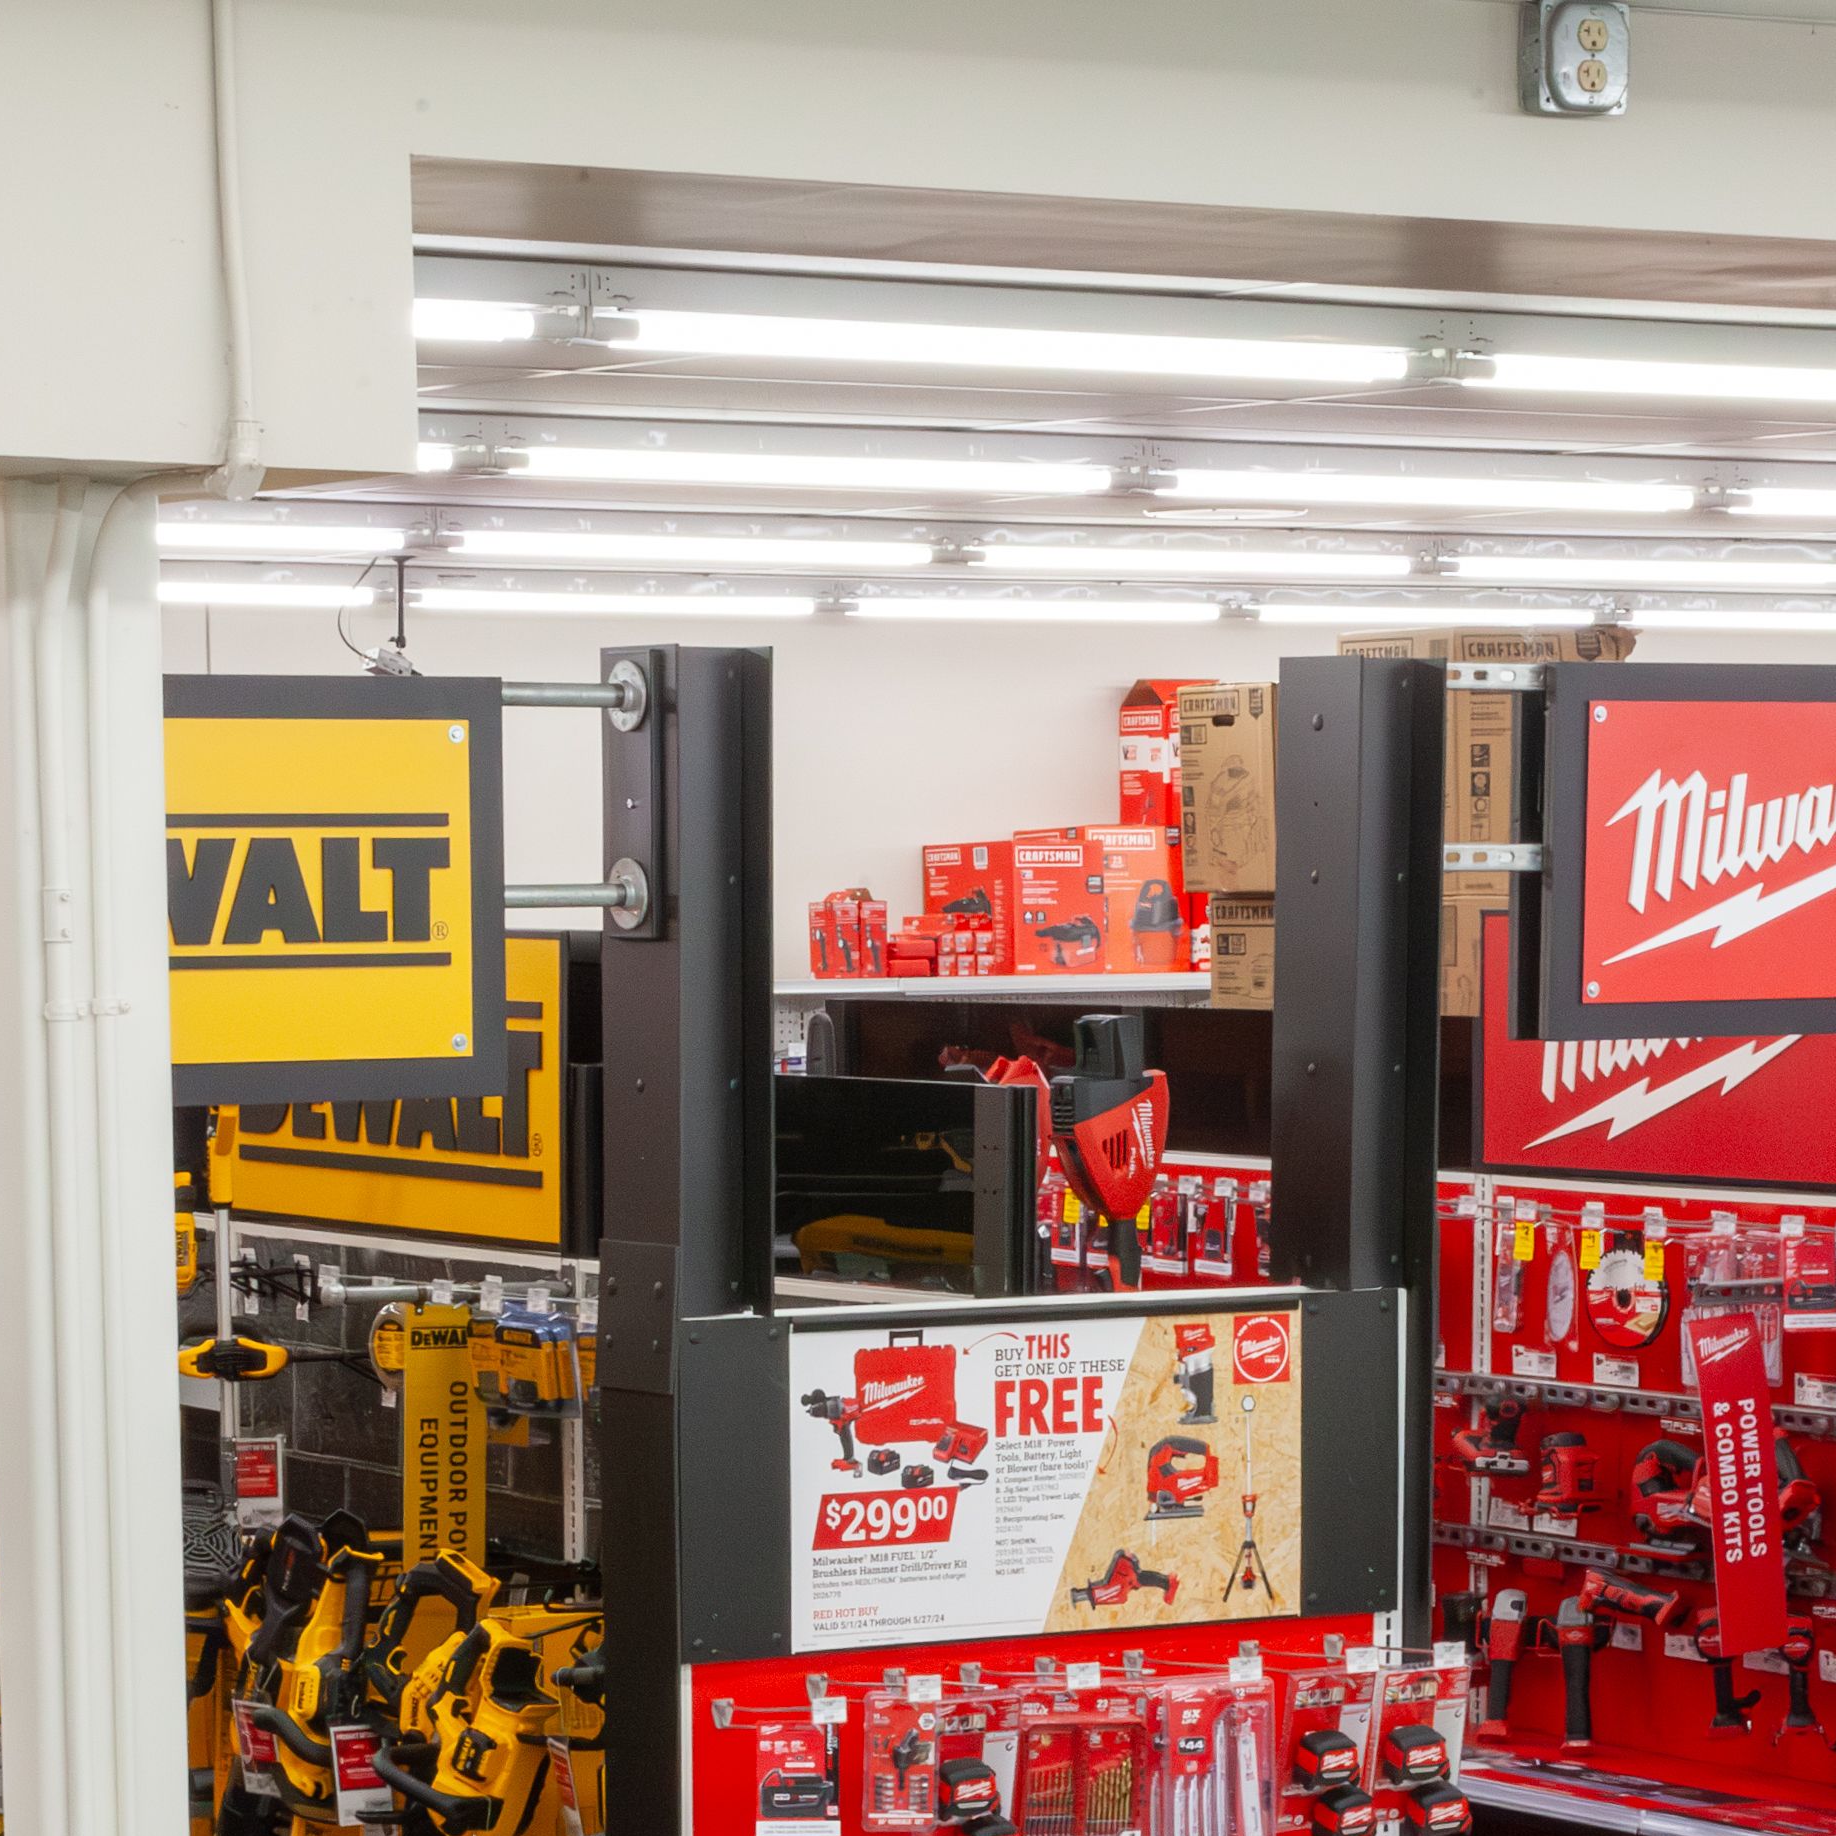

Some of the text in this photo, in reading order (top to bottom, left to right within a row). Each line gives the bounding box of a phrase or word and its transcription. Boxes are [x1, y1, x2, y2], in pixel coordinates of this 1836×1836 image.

[1466, 634, 1556, 659] CRAFTSMAN
[1183, 696, 1237, 712] CRAFTSMAN
[1123, 714, 1160, 728] CRAFTSMAN
[927, 851, 959, 863] CRAFTSMAN
[1020, 849, 1080, 863] CRAFTSMAN
[1136, 1098, 1157, 1169] Milwaukee
[996, 1333, 1070, 1361] BUY THIS
[995, 1360, 1125, 1377] GET ONE OF THESE
[995, 1376, 1103, 1437] FREE
[450, 1382, 469, 1501] OUTDOOR
[996, 1441, 1021, 1450] Select
[1060, 1450, 1081, 1459] Light
[1007, 1462, 1061, 1473] Blower (bare
[1740, 1398, 1767, 1558] POWER TOOLS
[1714, 1424, 1742, 1563] COMBO KITS
[891, 1552, 915, 1561] FUEL
[813, 1566, 898, 1578] Brushless Hammer
[813, 1607, 879, 1620] RED HOT BUY
[814, 1618, 911, 1631] VALID THROUGH
